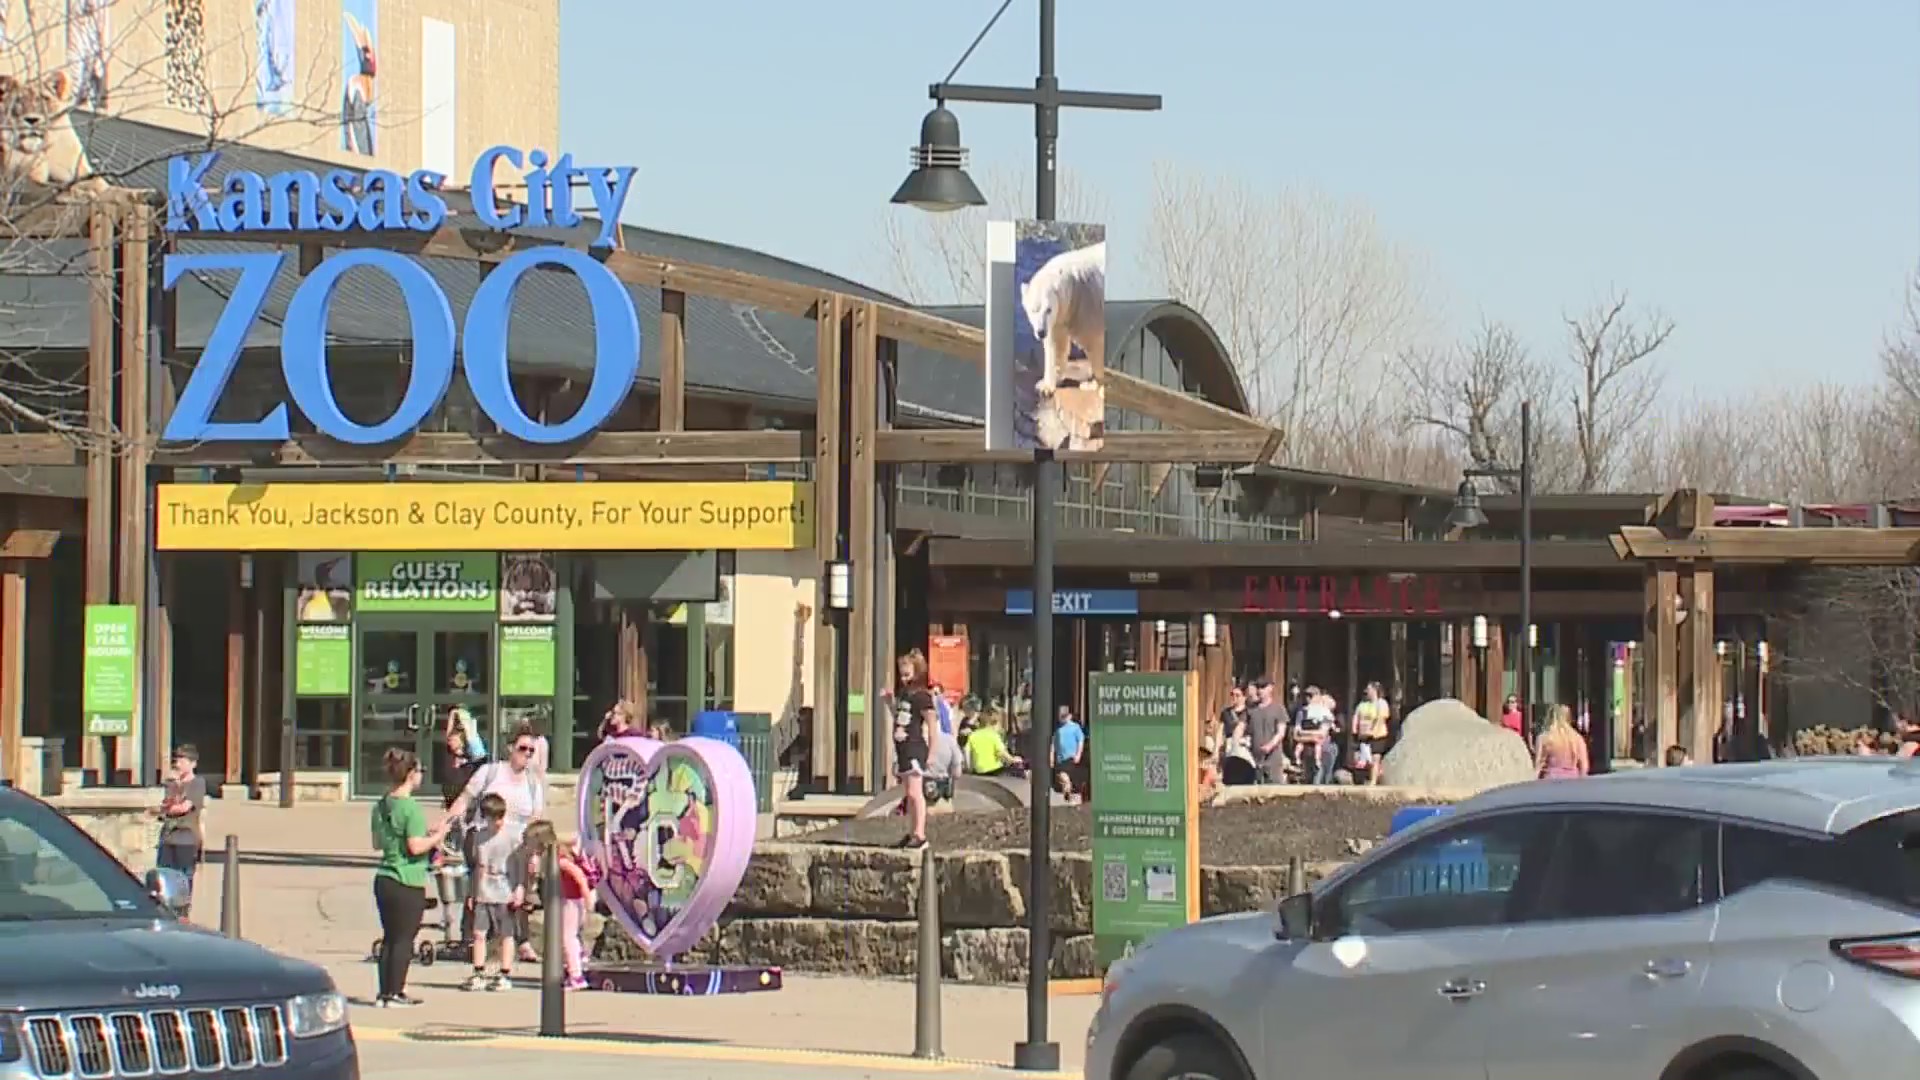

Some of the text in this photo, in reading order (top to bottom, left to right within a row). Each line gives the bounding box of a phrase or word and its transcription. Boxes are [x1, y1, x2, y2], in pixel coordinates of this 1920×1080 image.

[166, 145, 639, 248] Kansas City
[162, 246, 641, 444] ZOO
[168, 499, 806, 530] Thank You, Jackson & Clay County, For Your Support!
[392, 560, 463, 580] GUEST
[364, 581, 489, 600] RELATIONS
[1243, 575, 1442, 613] ENTRANCE
[1051, 592, 1092, 612] EXIT
[94, 623, 127, 633] OPEN
[96, 635, 126, 645] YEAR
[1099, 685, 1177, 699] BUY ONLINE &
[1098, 701, 1177, 716] SKIP THE LINE!
[135, 983, 181, 999] Jeep
